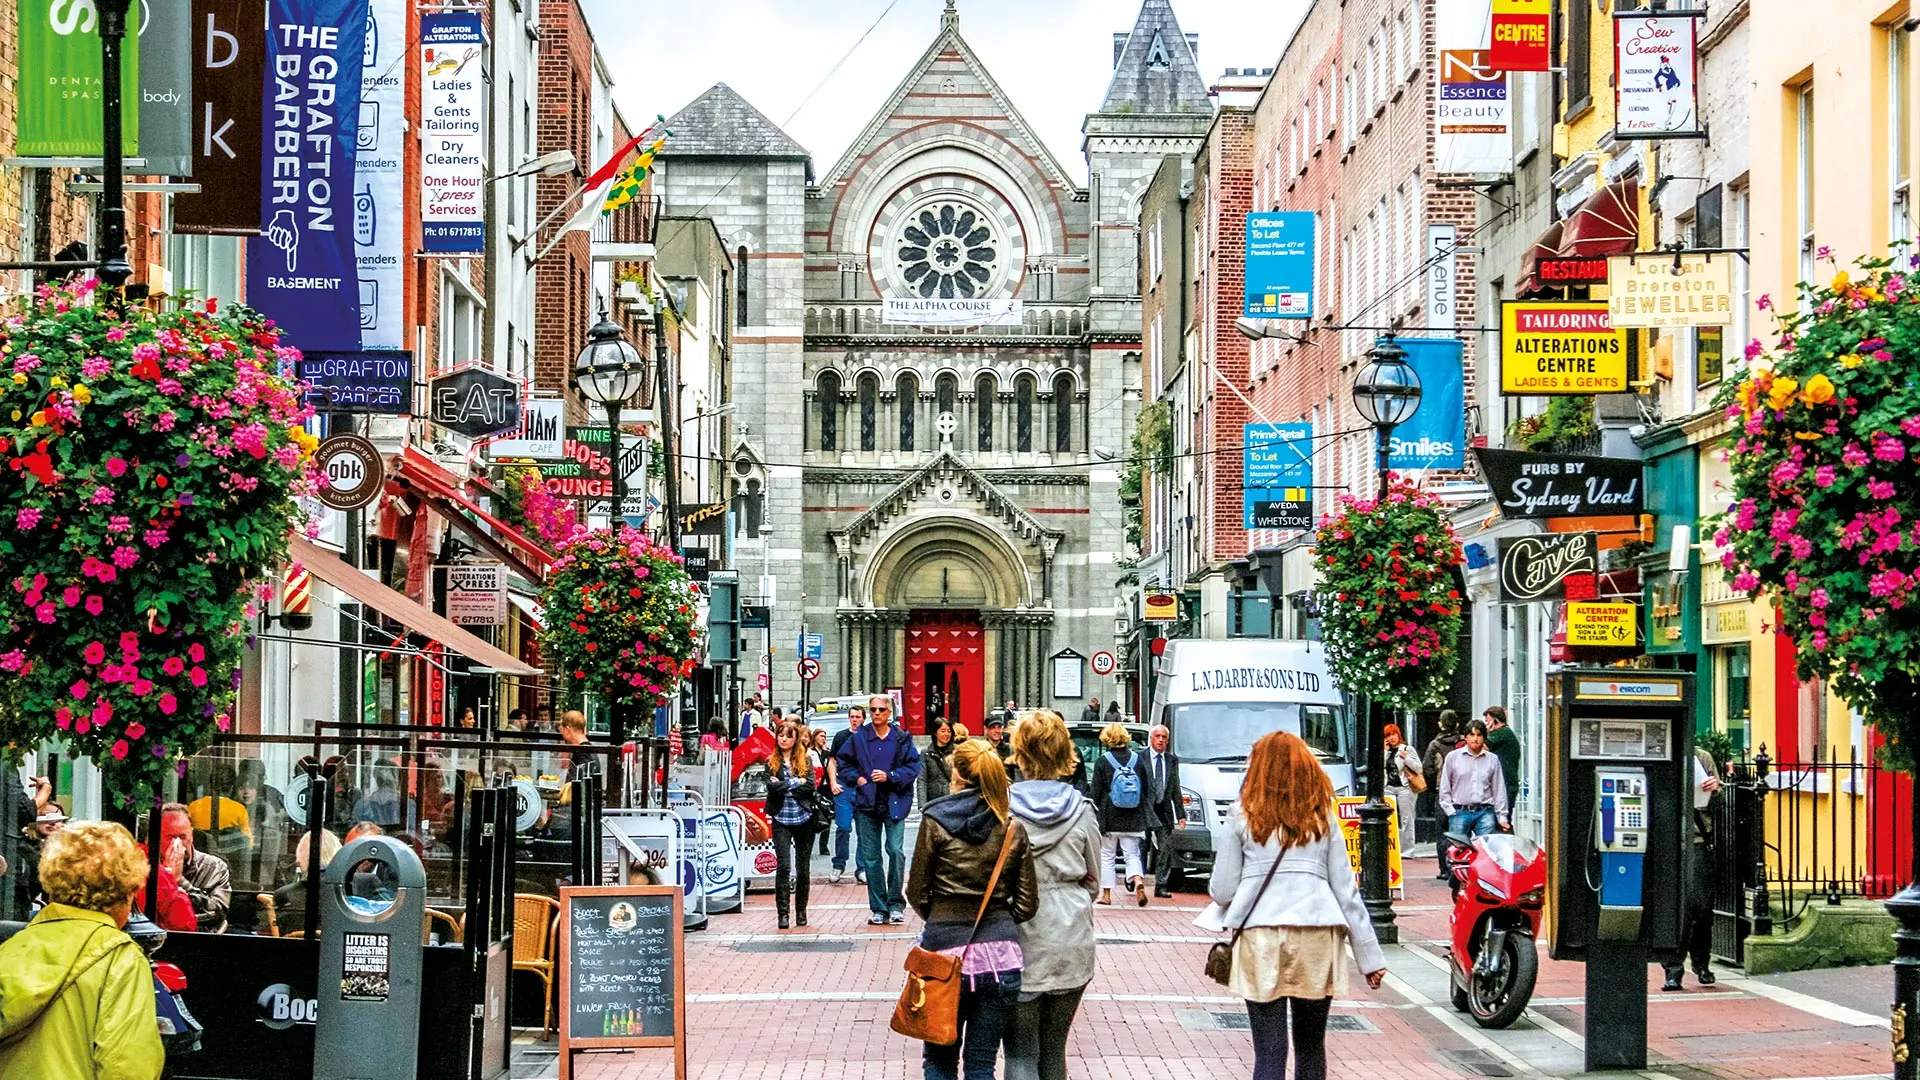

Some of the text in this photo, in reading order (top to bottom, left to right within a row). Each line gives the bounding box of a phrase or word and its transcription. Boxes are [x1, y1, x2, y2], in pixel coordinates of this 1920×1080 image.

[431, 26, 471, 34] GRAFTON
[1495, 24, 1546, 42] CENTRE
[1636, 18, 1675, 39] Sew
[279, 24, 339, 49] THE
[423, 34, 480, 42] ALTERATIONS
[1626, 38, 1681, 55] Creative
[49, 77, 102, 85] DENTA
[361, 76, 399, 86] enders
[433, 80, 472, 90] Ladies
[61, 91, 101, 99] SPAS
[1441, 84, 1506, 98] Essence
[143, 88, 181, 106] body
[448, 93, 457, 103] &
[434, 106, 471, 117] Gents
[1439, 104, 1504, 120] Beauty
[272, 54, 301, 204] BARBER
[425, 119, 479, 133] Tailoring
[306, 55, 339, 231] GRAFTON
[441, 141, 464, 153] Dry
[425, 154, 479, 165] Cleaners
[424, 176, 481, 186] One Hour
[430, 188, 475, 202] Xpress
[429, 204, 477, 215] Services
[1251, 218, 1285, 228] Offices
[424, 227, 481, 237] Ph: 01 6717813
[1251, 229, 1280, 239] To Let
[1541, 260, 1608, 279] RESTAUR
[1636, 261, 1705, 275] Loran
[267, 276, 341, 290] BASEMENT
[888, 301, 991, 310] THE ALPHA COURSE
[1611, 294, 1731, 314] JEWELLER
[1522, 313, 1609, 329] TAILORING
[1515, 338, 1620, 354] ALTERATIONS
[323, 359, 408, 378] GRAFTON
[1537, 357, 1597, 373] CENTRE
[1514, 377, 1619, 387] LADIES & GENTS
[437, 382, 514, 425] EAT
[1249, 430, 1306, 440] Prime Retail
[1249, 440, 1269, 451] Unit
[1389, 437, 1454, 456] Smiles
[319, 441, 373, 462] gourmet burger
[1249, 452, 1278, 461] To Let
[564, 440, 612, 475] HOES
[328, 460, 362, 482] gbk
[1521, 463, 1585, 475] FURS BY
[546, 478, 612, 496] OUNGE
[330, 492, 361, 502] kitchen
[1503, 476, 1638, 514] Sydney Vard
[1268, 502, 1299, 510] AVEDA
[1257, 517, 1311, 527] WHETSTONE
[1576, 607, 1628, 615] ALTERATION
[461, 616, 495, 624] 6717813
[1586, 615, 1619, 623] CENTRE
[1097, 657, 1109, 667] 50
[1297, 671, 1320, 693] LTD
[346, 935, 388, 946] LITTER IS
[345, 945, 388, 955] DISGUSTING
[345, 956, 354, 964] SO
[367, 957, 388, 965] THOSE
[345, 964, 388, 972] RESPONSIBLE
